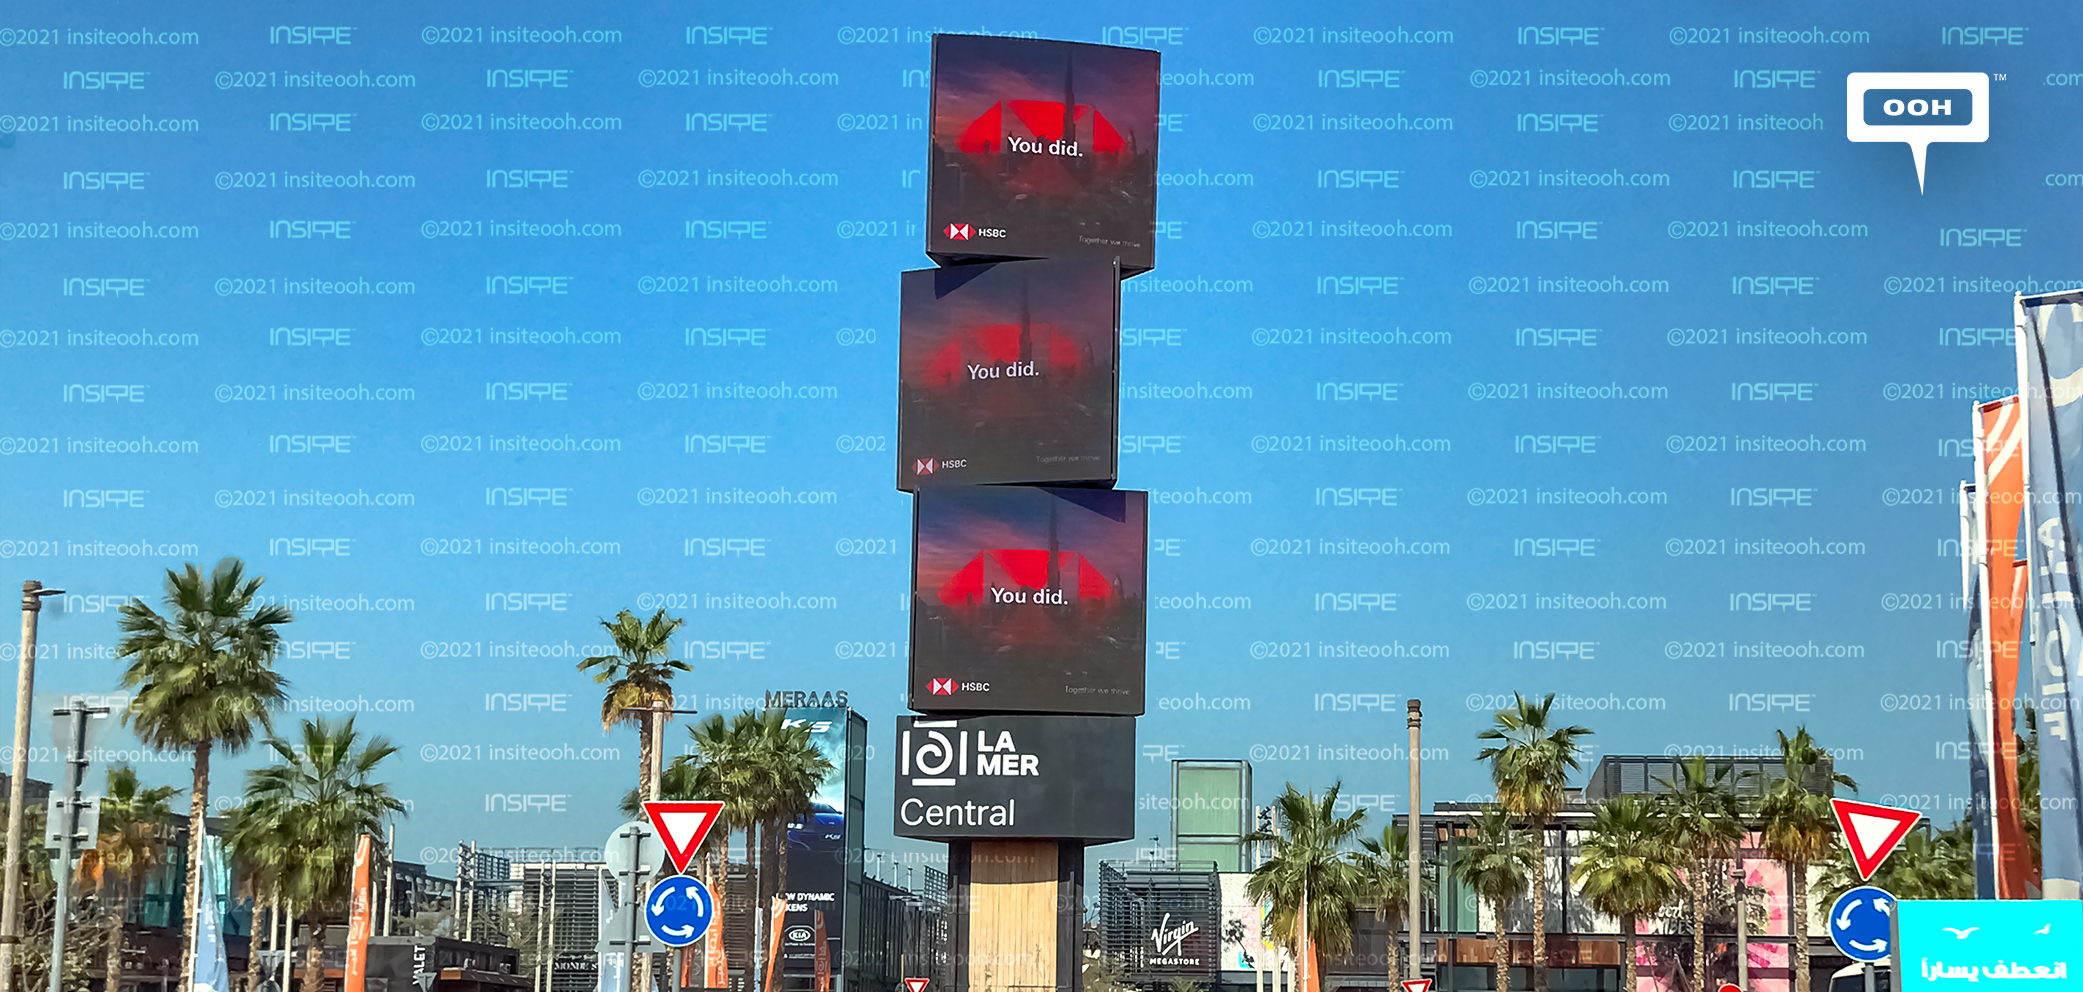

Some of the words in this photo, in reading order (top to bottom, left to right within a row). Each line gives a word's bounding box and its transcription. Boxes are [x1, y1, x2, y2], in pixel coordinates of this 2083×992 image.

[1007, 136, 1042, 154] You
[1048, 139, 1083, 158] did.
[979, 228, 1007, 238] HSBC
[967, 364, 1000, 380] You
[1006, 360, 1040, 378] did.
[942, 459, 967, 469] HSBC
[991, 587, 1026, 605] You
[1032, 588, 1068, 605] did.
[961, 682, 990, 692] HSBC
[765, 690, 849, 708] MERAAS
[977, 730, 1016, 752] LA
[977, 754, 1040, 776] MER
[900, 798, 1015, 826] Central
[797, 893, 835, 901] DYNAMIC
[1151, 912, 1200, 956] Virgin
[1149, 957, 1200, 966] MEGASTORE
